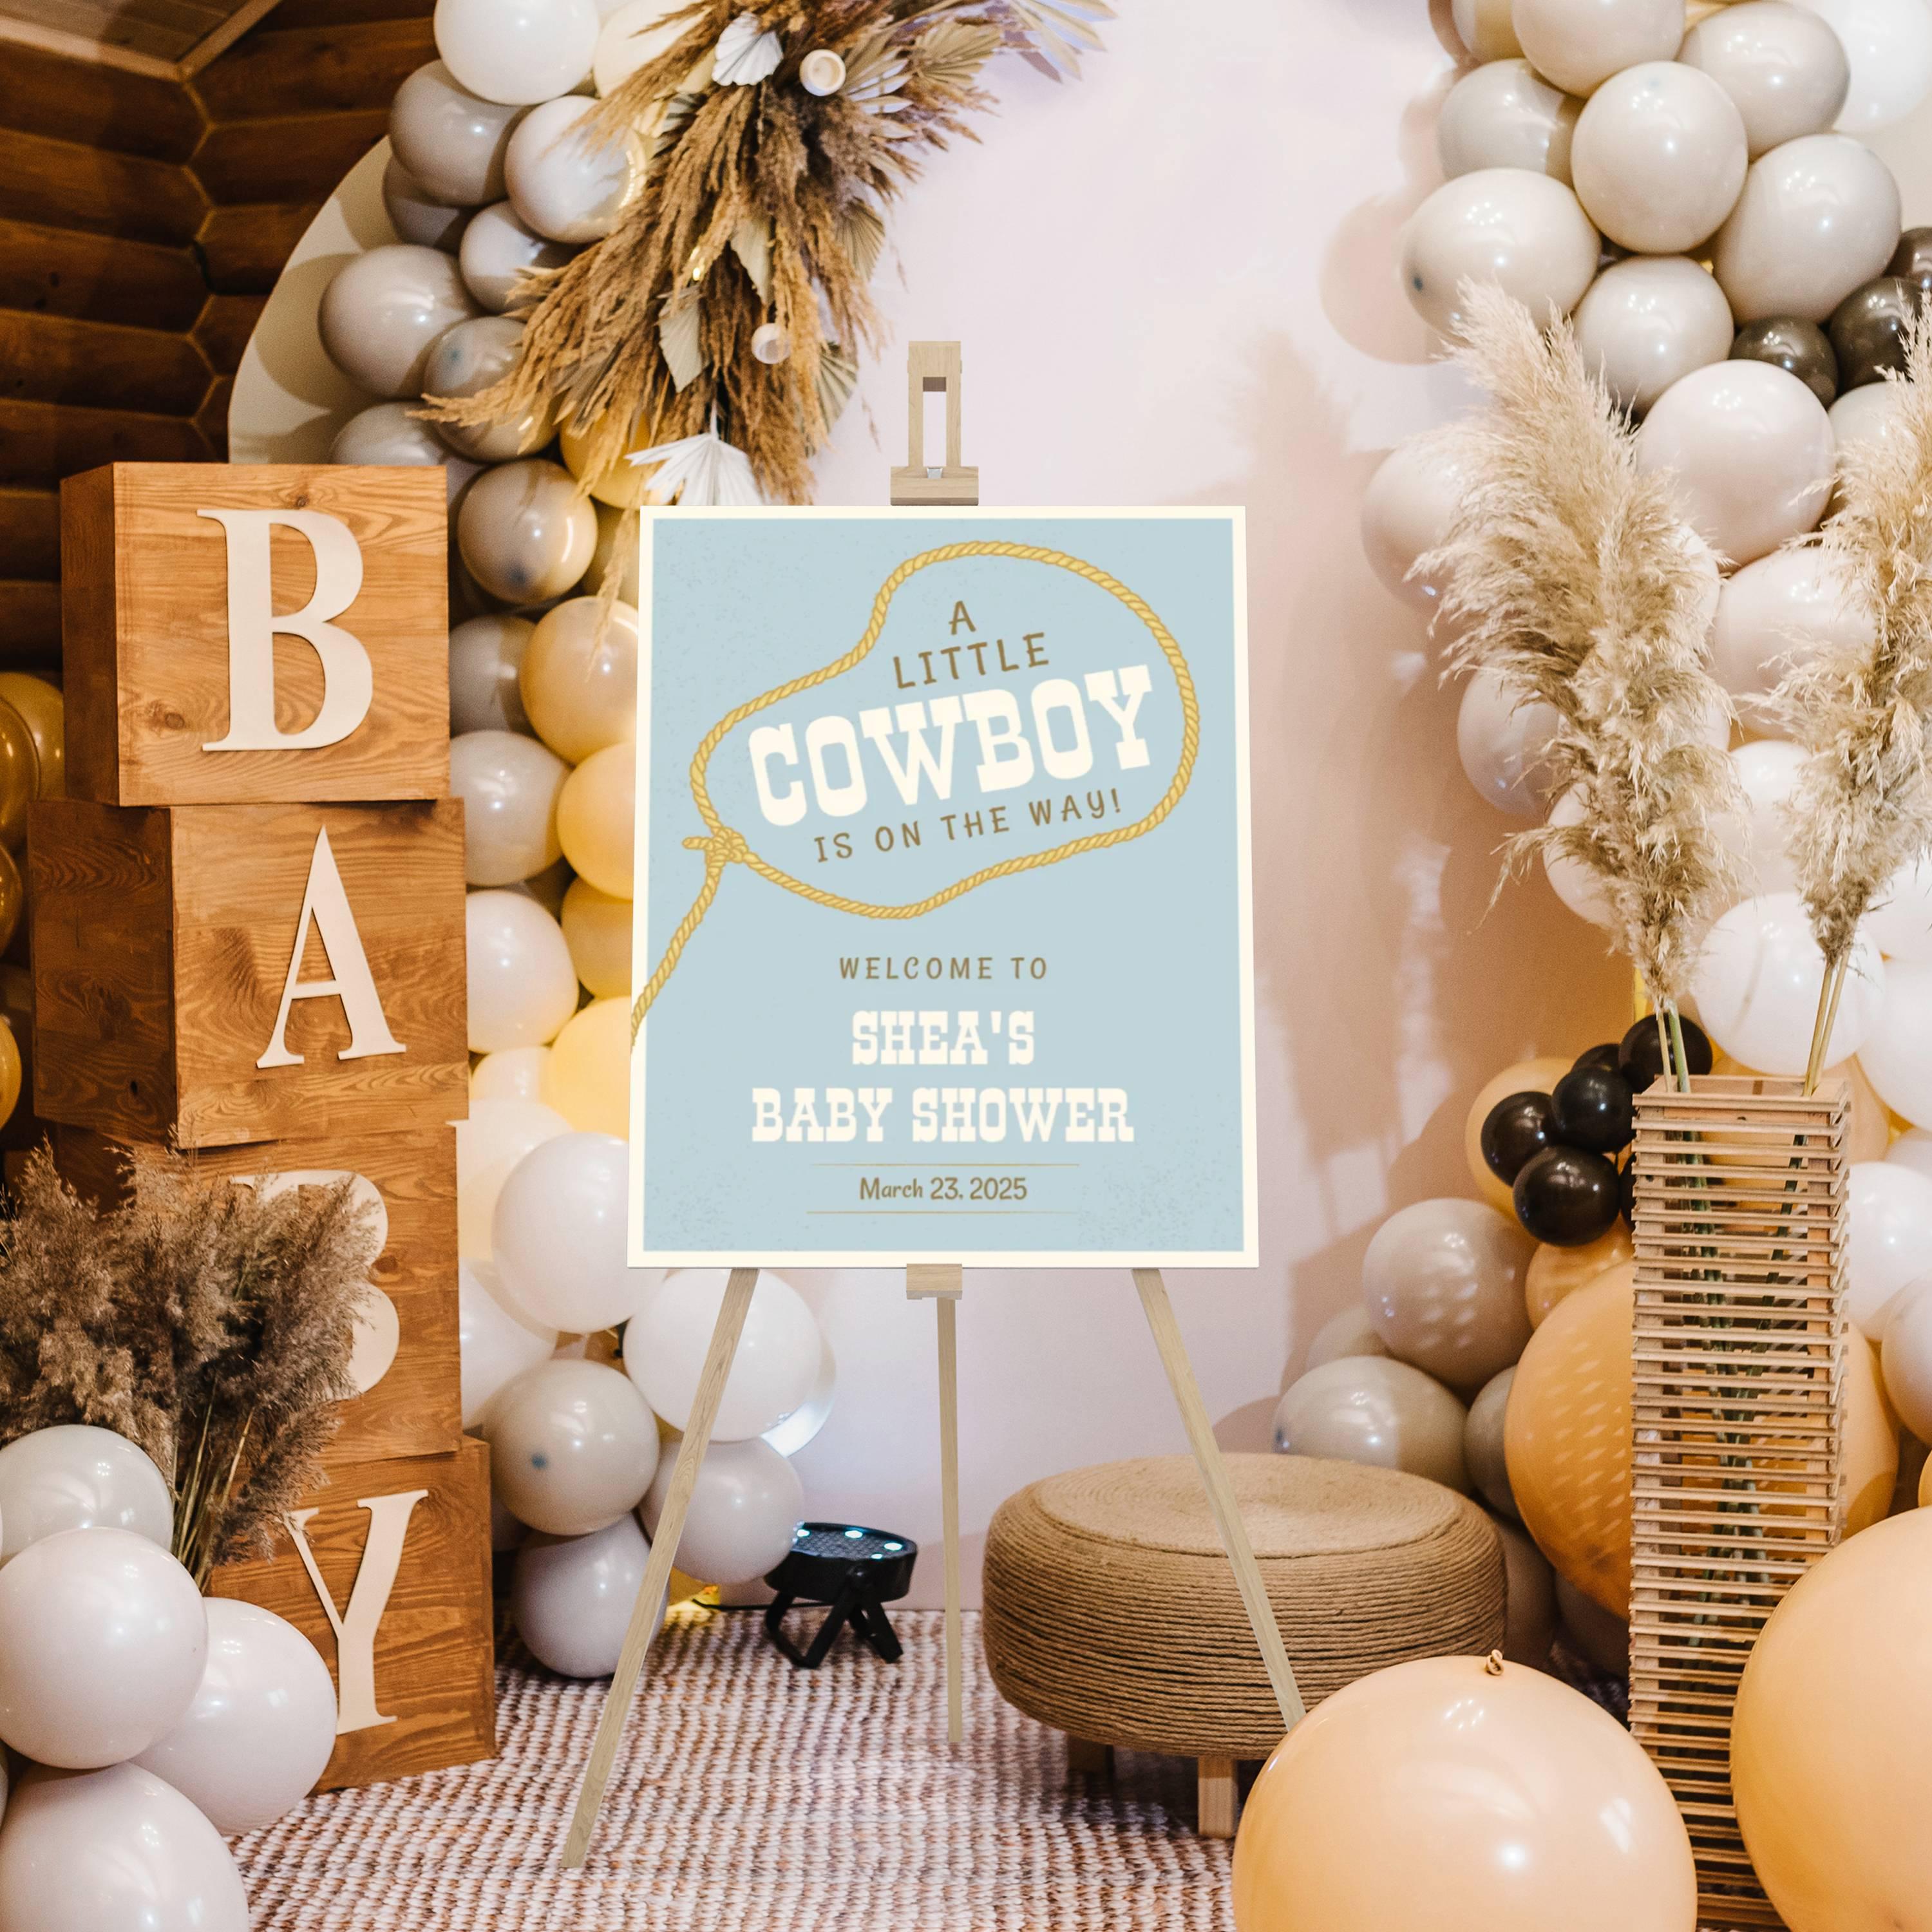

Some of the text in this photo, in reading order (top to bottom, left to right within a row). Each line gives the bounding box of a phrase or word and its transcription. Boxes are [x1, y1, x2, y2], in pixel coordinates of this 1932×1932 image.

[948, 599, 978, 636] A
[893, 632, 1050, 690] LITTLE
[748, 663, 1152, 827] COWBOY
[814, 786, 1122, 864] IS ON THE WAY!
[838, 956, 1048, 980] WELCOME TO
[852, 1010, 1034, 1066] SHEA'S
[752, 1087, 1134, 1142] BABY SHOWER
[858, 1175, 924, 1201] March
[968, 1175, 1028, 1202] 2025
